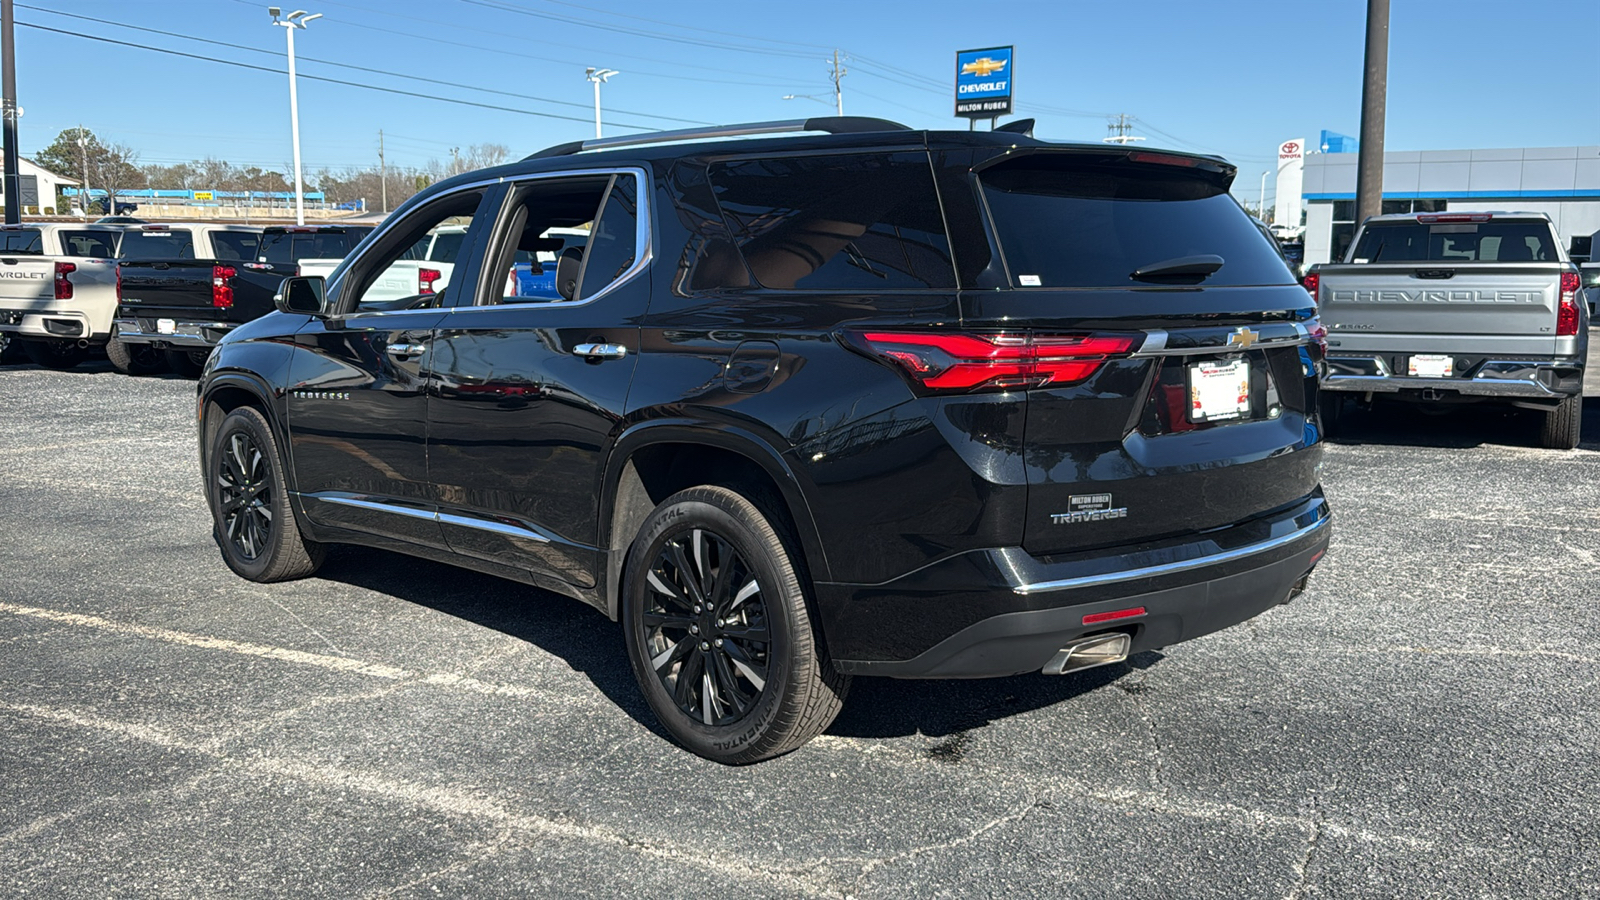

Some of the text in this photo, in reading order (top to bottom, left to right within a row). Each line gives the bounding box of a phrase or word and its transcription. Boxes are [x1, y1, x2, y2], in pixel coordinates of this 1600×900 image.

[959, 81, 1007, 93] CHEVROLET
[957, 101, 1007, 112] MILTON RUBEN
[1332, 290, 1542, 303] CHEVROLET
[293, 391, 350, 400] TRAVERSE
[1071, 495, 1109, 504] MILTON RUBEN
[1050, 507, 1128, 524] TRAVERSE
[712, 662, 784, 751] CONTINENTAL
